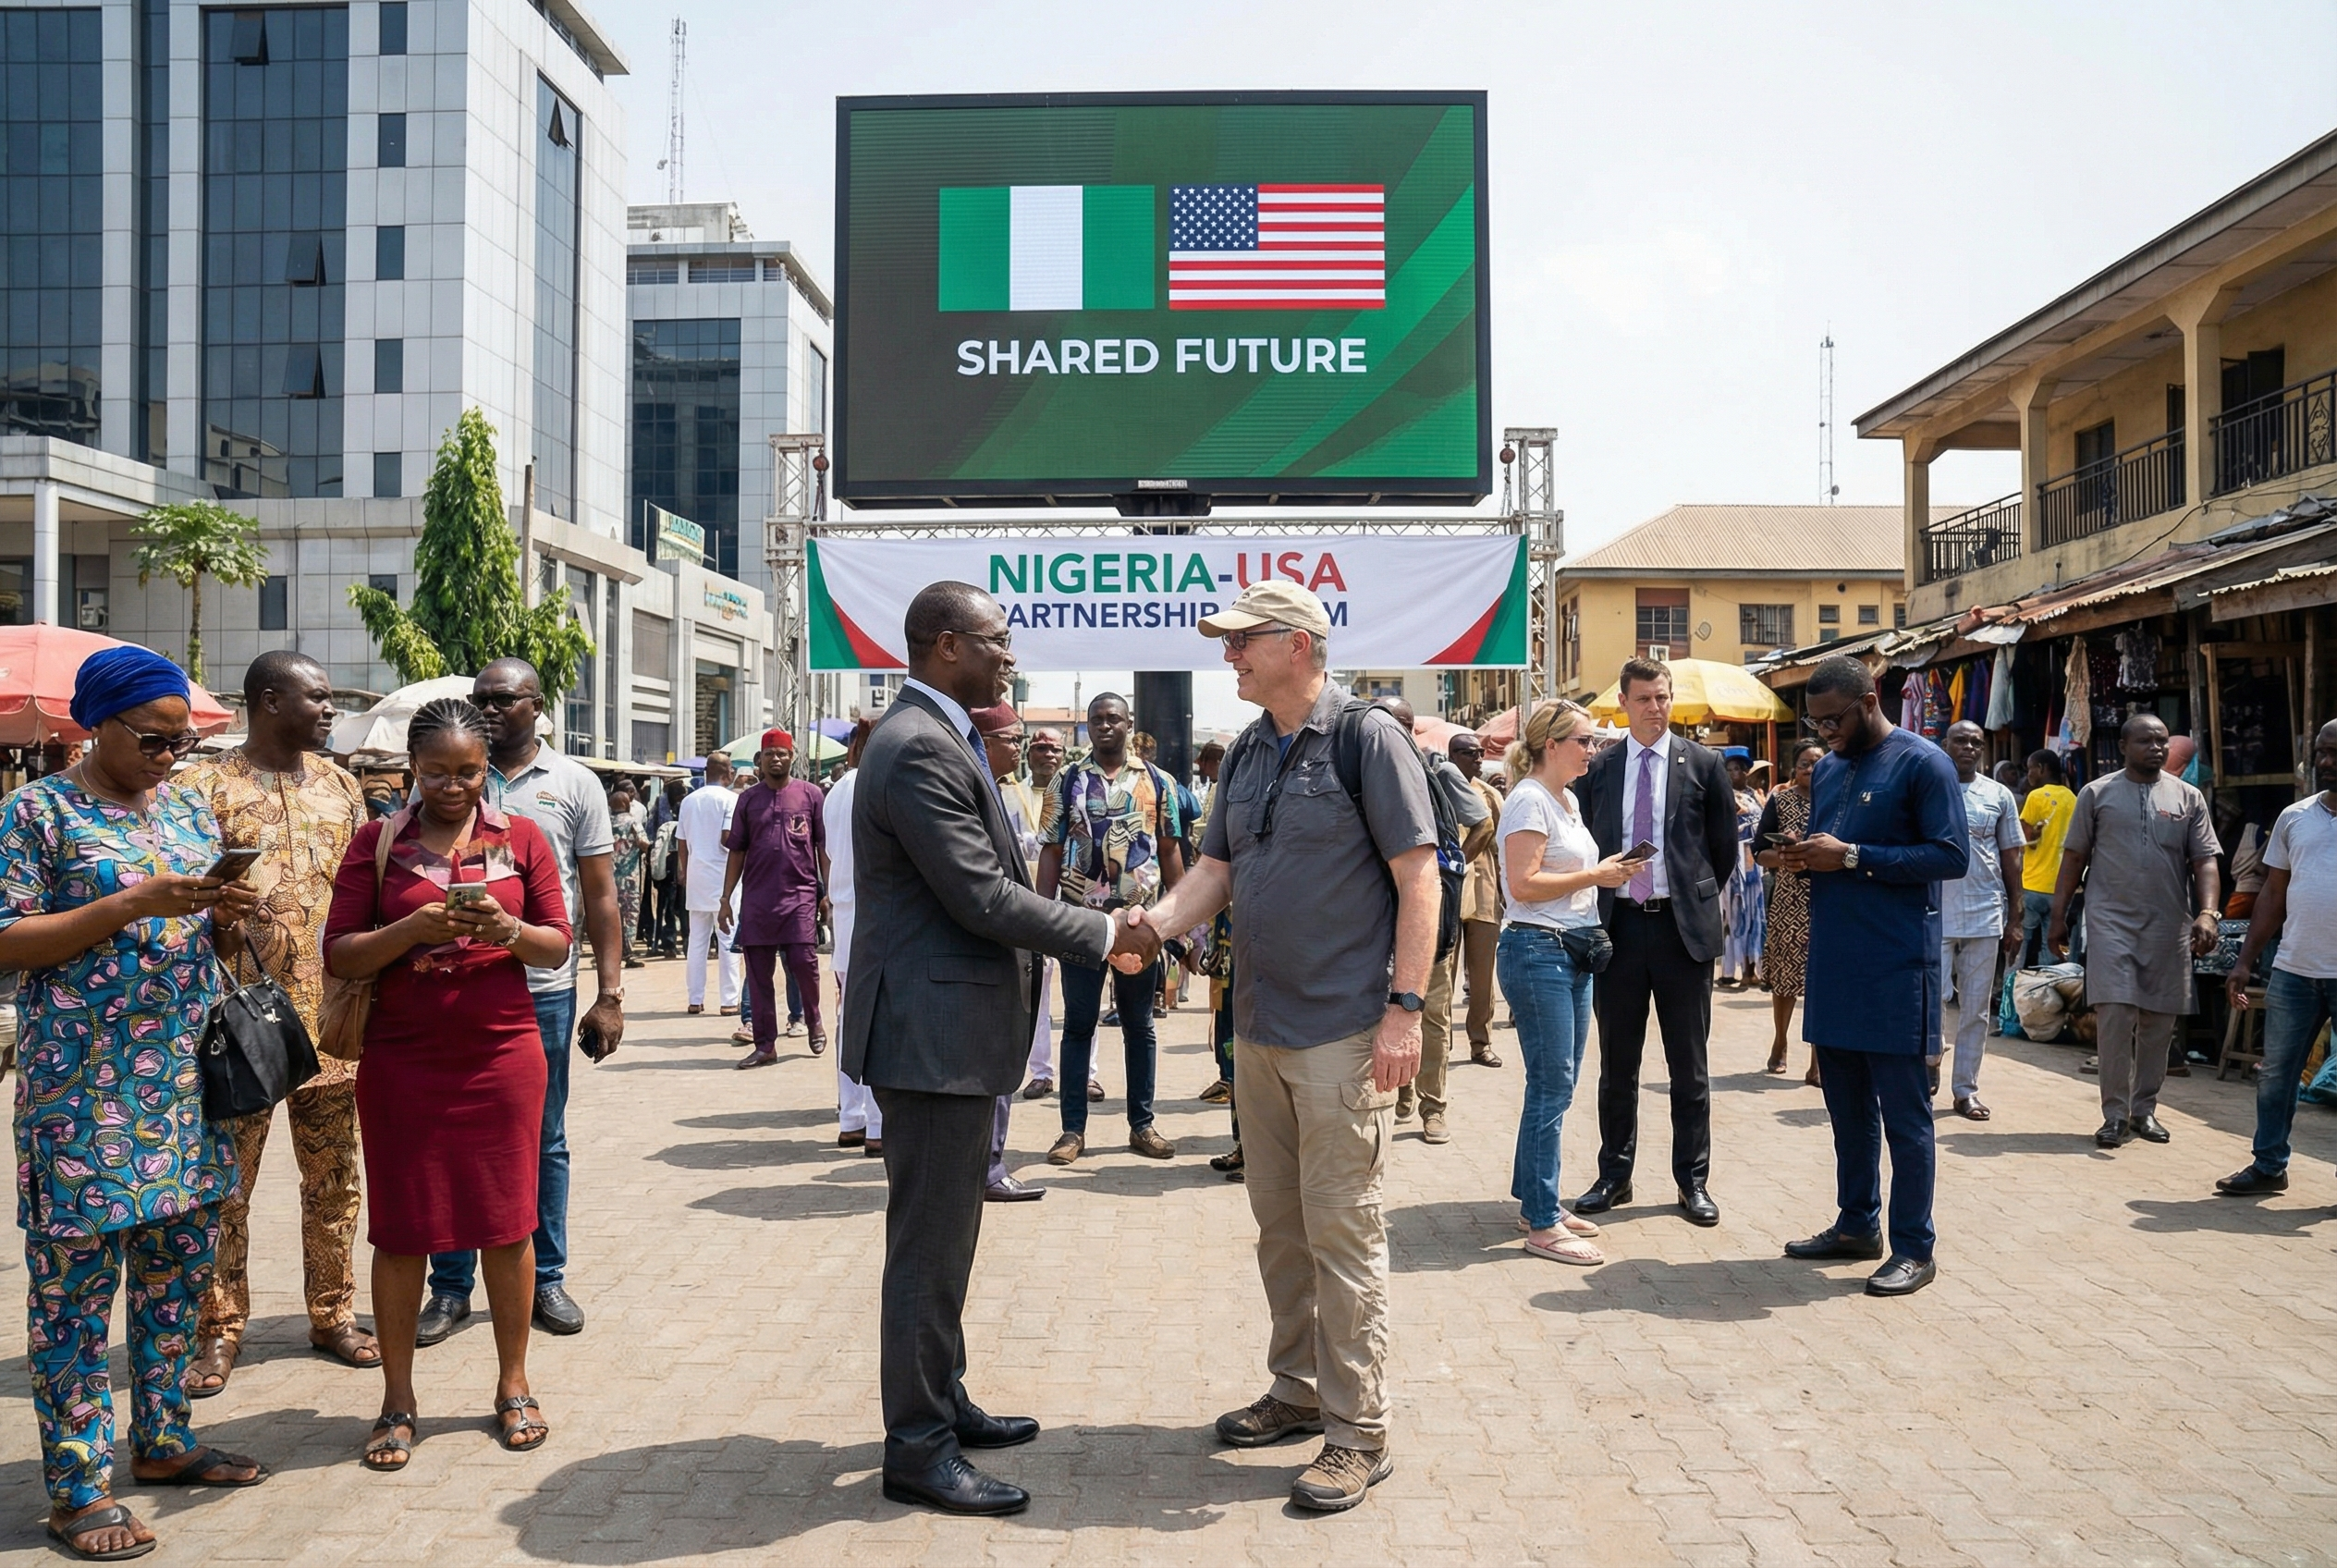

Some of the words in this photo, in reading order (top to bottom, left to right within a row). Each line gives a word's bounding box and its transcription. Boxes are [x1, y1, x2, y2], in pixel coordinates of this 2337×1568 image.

[957, 338, 1159, 375] SHARED
[1176, 337, 1367, 374] FUTURE
[989, 552, 1348, 594] NIGERIA-USA
[998, 602, 1219, 628] ARTNERSHIP
